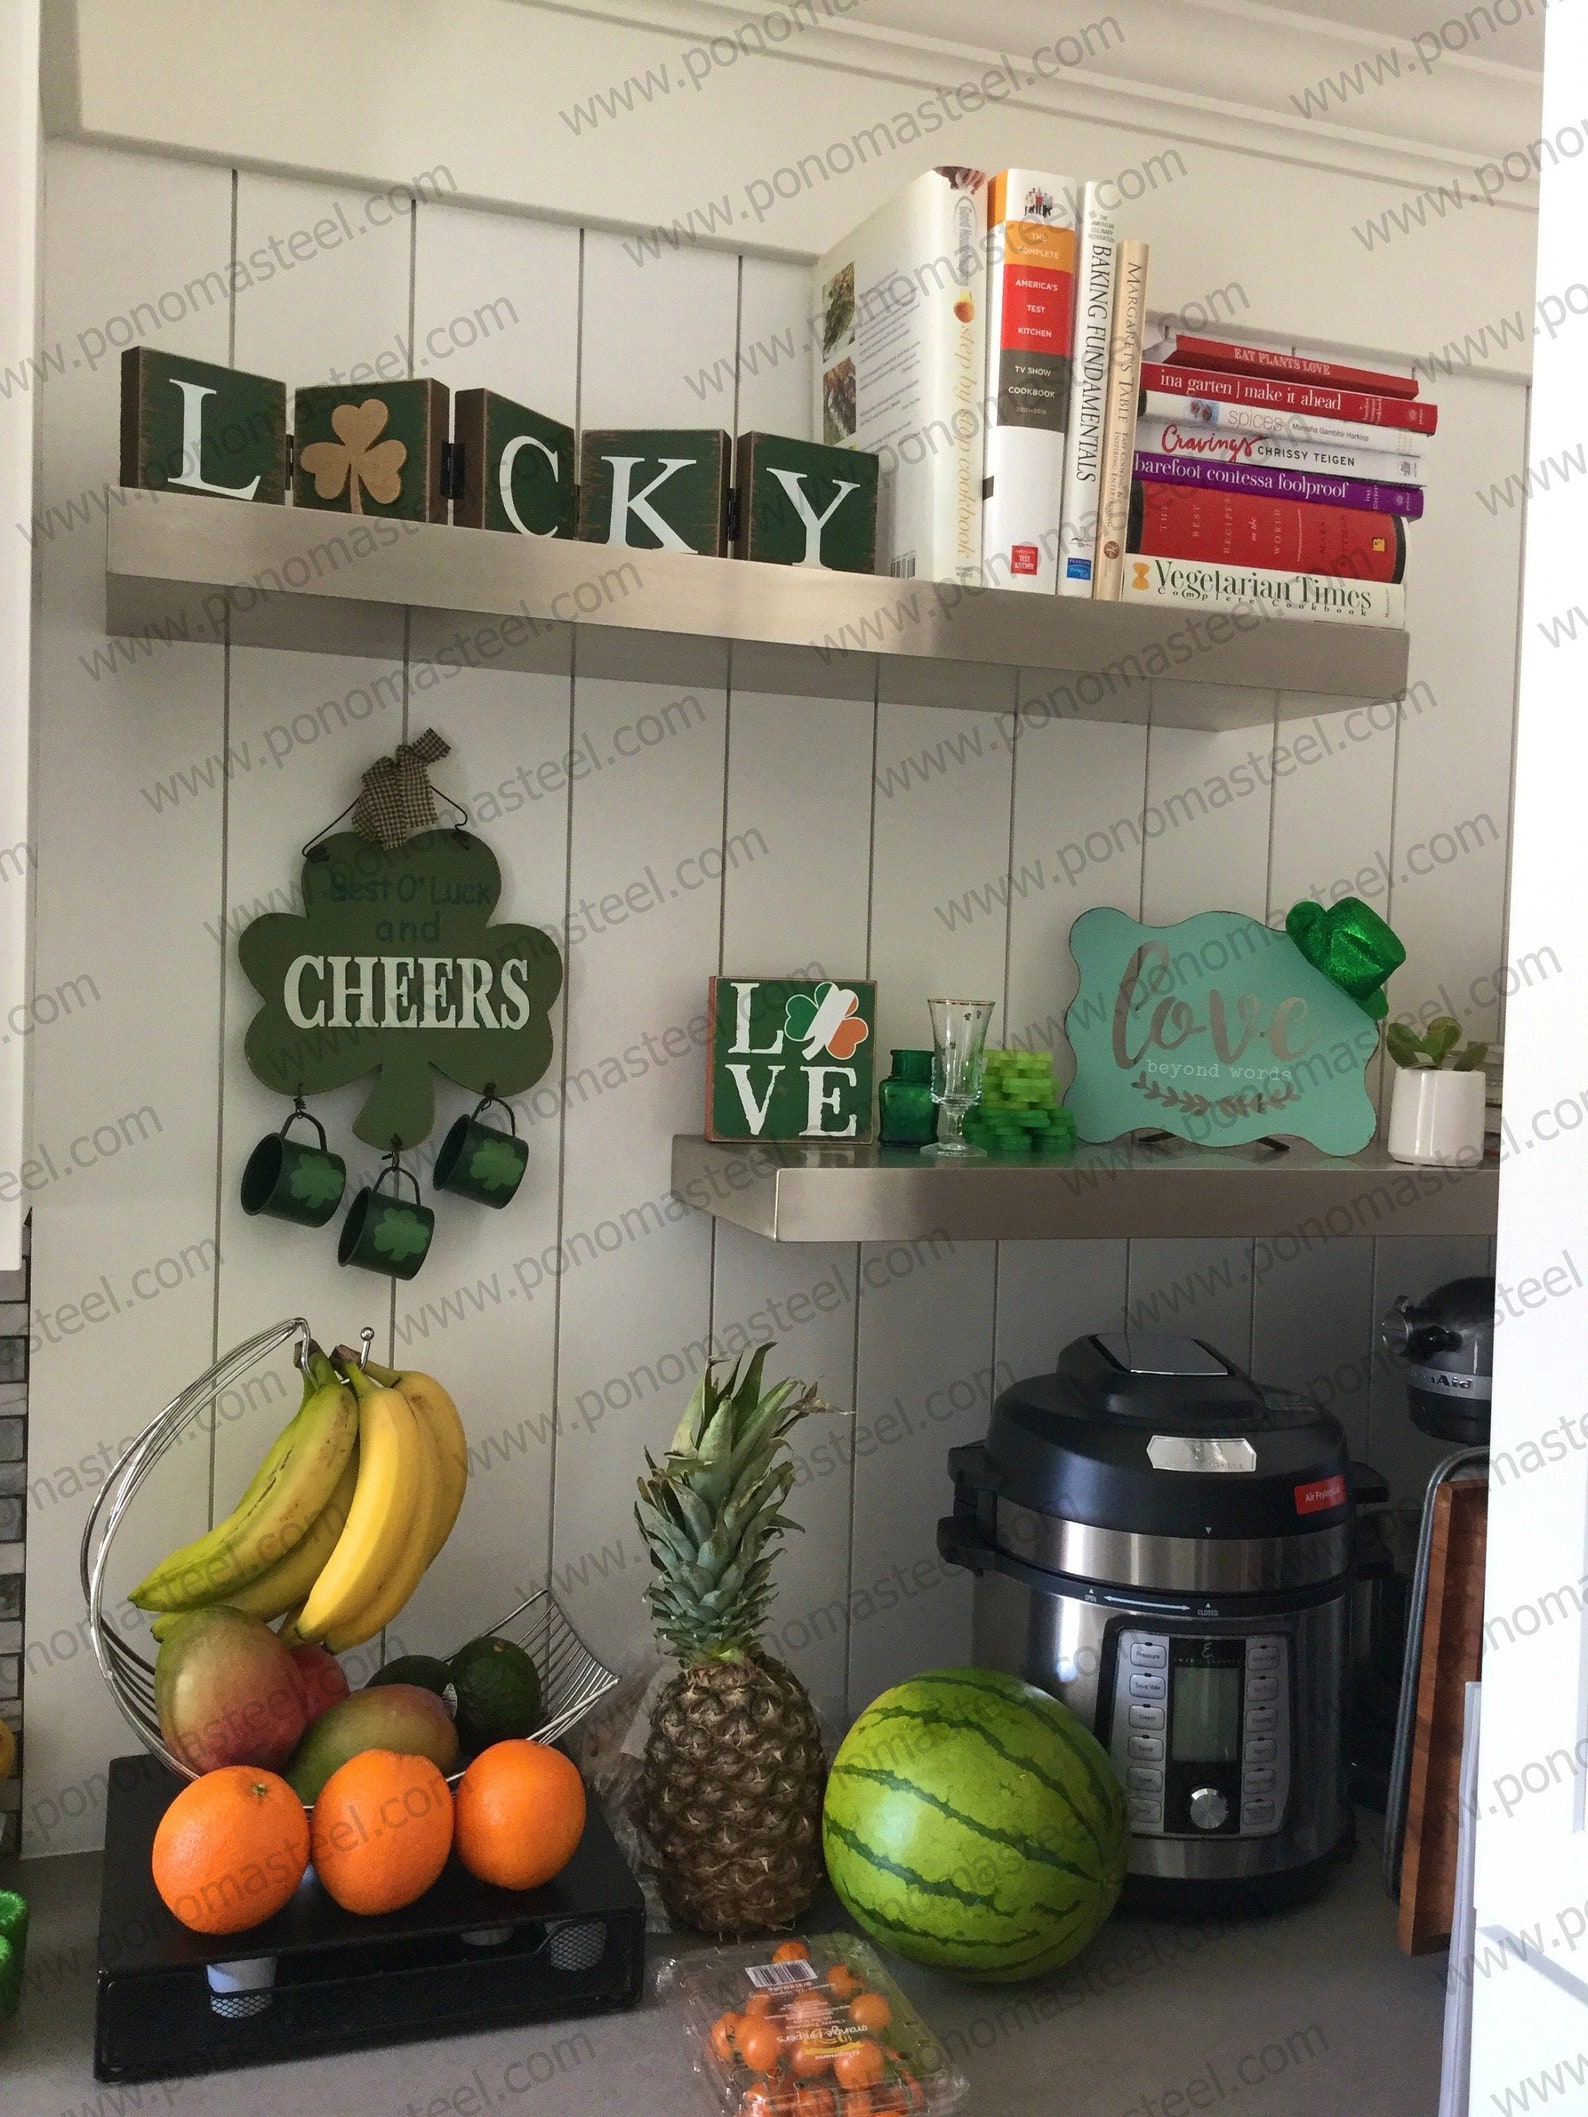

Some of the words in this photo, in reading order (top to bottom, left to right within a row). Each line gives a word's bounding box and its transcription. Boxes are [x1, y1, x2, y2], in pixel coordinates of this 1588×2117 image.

[1032, 232, 1047, 242] THE
[1017, 246, 1060, 260] COMPLETE
[1015, 279, 1059, 291] AMERICA'S
[1089, 244, 1112, 320] BAKING
[1026, 304, 1046, 315] TEST
[1018, 326, 1052, 338] KITCHEN
[954, 325, 975, 370] step
[1014, 365, 1026, 374] TV
[1027, 366, 1052, 377] SHOW
[1233, 347, 1256, 361] EAT
[1258, 353, 1300, 370] PLANTS
[1302, 359, 1331, 375] LOVE
[956, 380, 976, 404] by
[1008, 386, 1056, 398] COOKBOOK
[1118, 376, 1135, 424] TABLE
[1160, 369, 1182, 388] ina
[1186, 377, 1232, 396] garten
[1244, 384, 1283, 404] make
[1286, 387, 1296, 404] it
[1300, 390, 1342, 411] ahead
[1077, 324, 1106, 483] FUNDAMENTALS
[953, 409, 974, 452] step
[1228, 410, 1284, 432] spices
[1161, 424, 1271, 462] Cravings
[1258, 446, 1308, 460] CHRISSY
[1314, 453, 1355, 467] TEIGEN
[1134, 453, 1202, 479] barefoot
[1206, 468, 1273, 489] contessa
[1278, 473, 1349, 499] foolproof
[957, 459, 976, 557] cookbook
[1155, 559, 1290, 600] Vegetarian
[1296, 576, 1372, 609] Times
[1271, 599, 1367, 617] Cookbook
[375, 911, 441, 942] and
[284, 954, 530, 1030] CHEERS
[1146, 1060, 1220, 1079] beyond
[1230, 1066, 1293, 1081] words
[1084, 1594, 1097, 1604] OPEN
[1197, 1609, 1219, 1617] CLOSED
[1136, 1651, 1161, 1660] Pressure
[824, 2025, 868, 2039] orange
